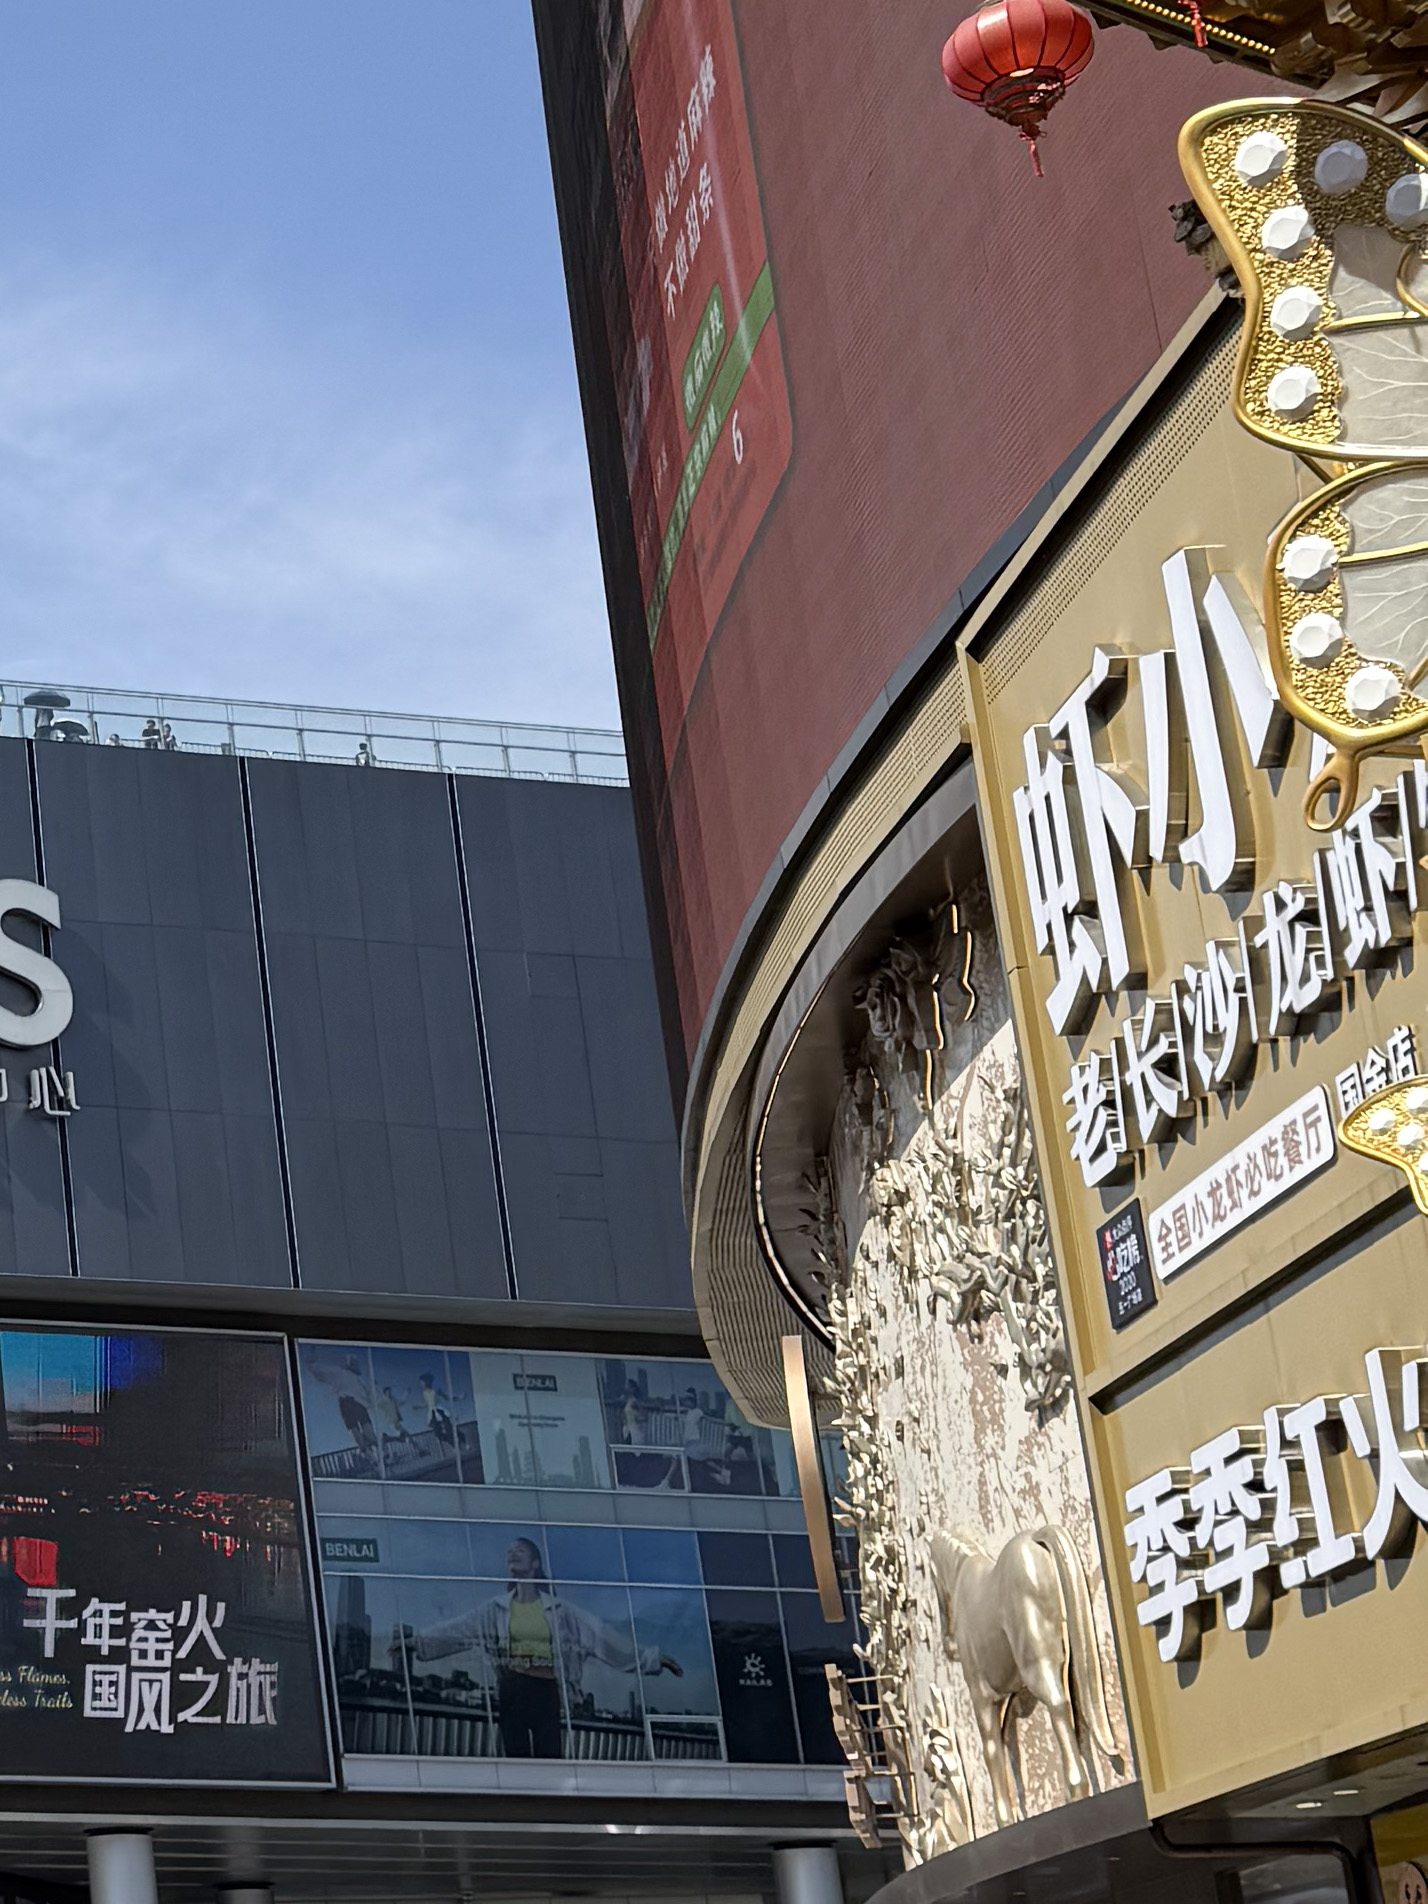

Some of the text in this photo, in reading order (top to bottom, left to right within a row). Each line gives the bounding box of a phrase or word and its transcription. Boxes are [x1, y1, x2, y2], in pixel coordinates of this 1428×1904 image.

[1013, 548, 1329, 1035] 虾小
[1063, 759, 1428, 1188] 老长沙龙虾
[1156, 1101, 1325, 1266] 全国小龙虾必吃餐厅
[325, 1540, 375, 1559] BENLAI
[1125, 1349, 1428, 1663] 季季红火
[23, 1587, 227, 1667] 千年窑火
[83, 1657, 279, 1733] 国风之旅
